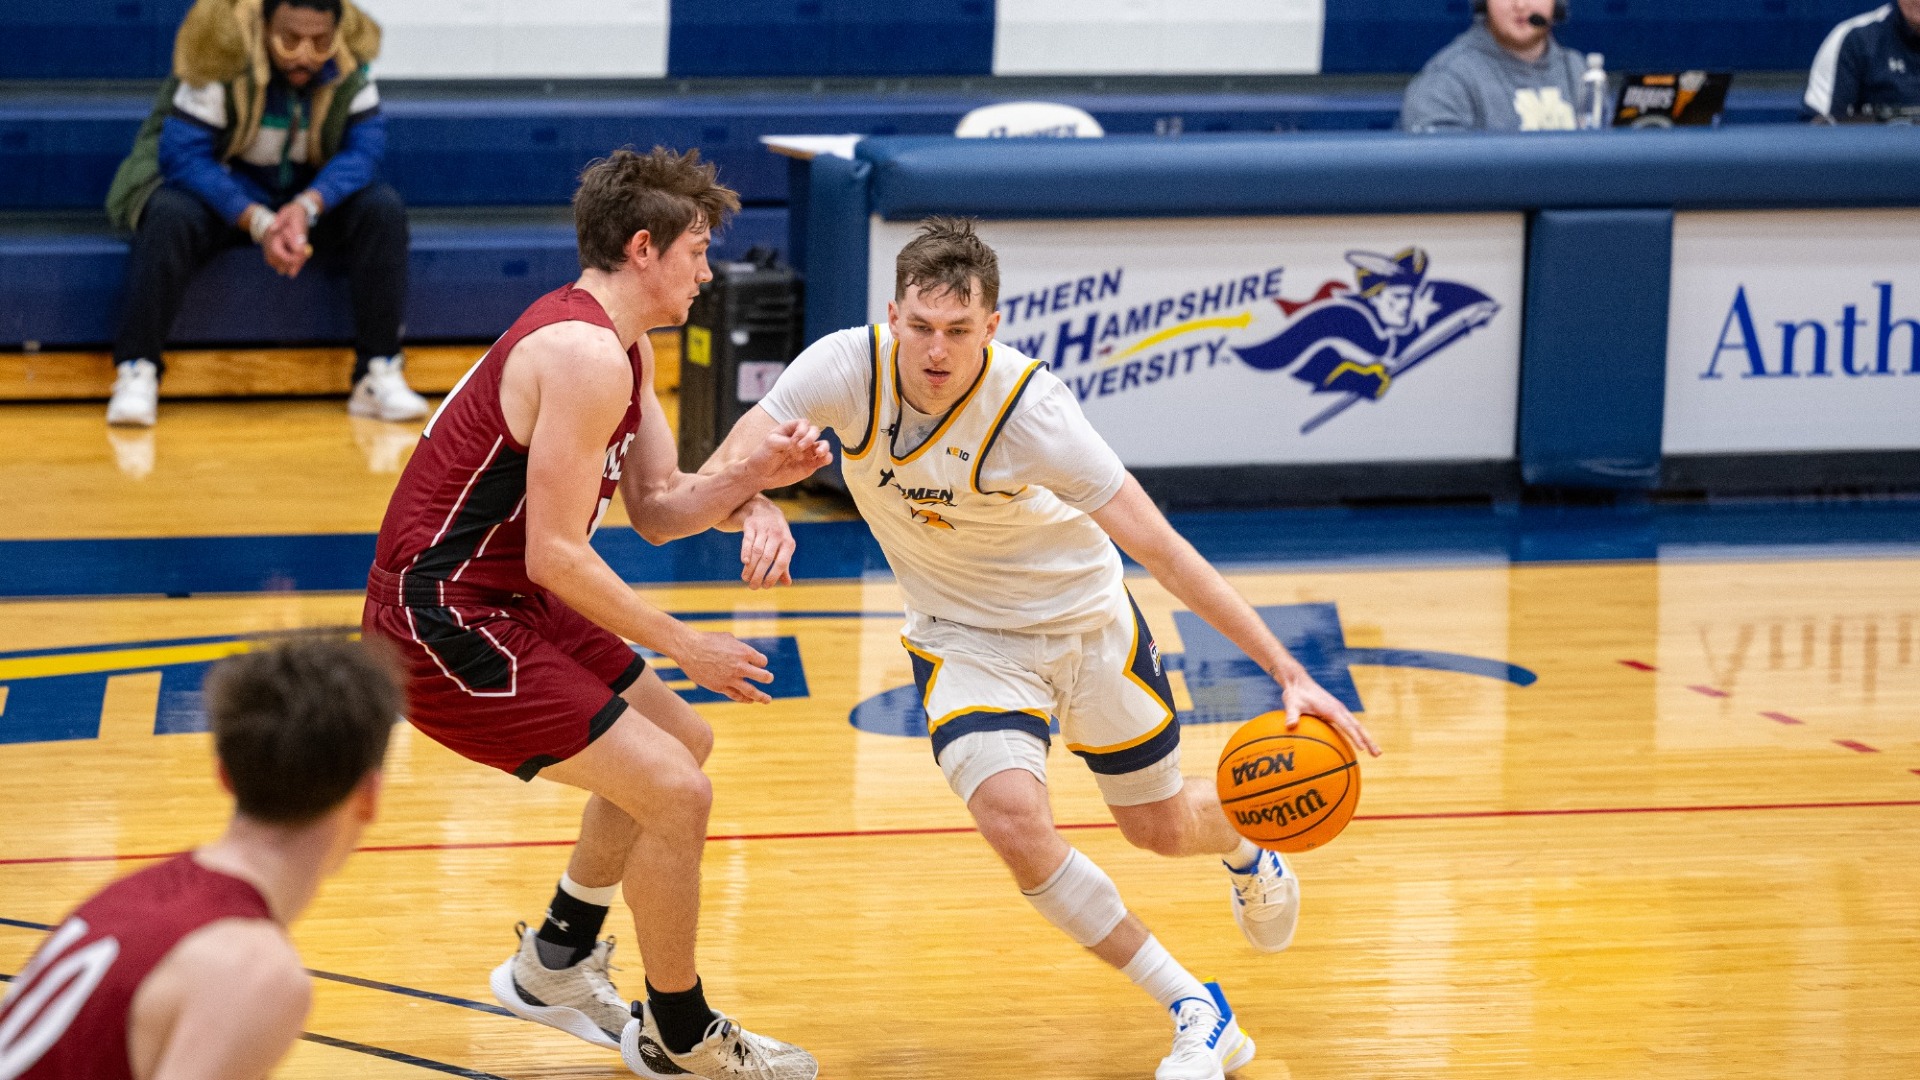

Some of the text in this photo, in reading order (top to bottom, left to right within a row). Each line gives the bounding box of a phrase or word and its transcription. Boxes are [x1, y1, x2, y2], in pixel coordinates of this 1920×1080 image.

[997, 267, 1122, 325] THERN
[1052, 267, 1285, 371] HAMPSHIRE
[1698, 280, 1920, 380] Anth
[1064, 337, 1229, 402] VERSITY
[1232, 752, 1294, 787] NCAA
[1234, 789, 1328, 827] Wilson
